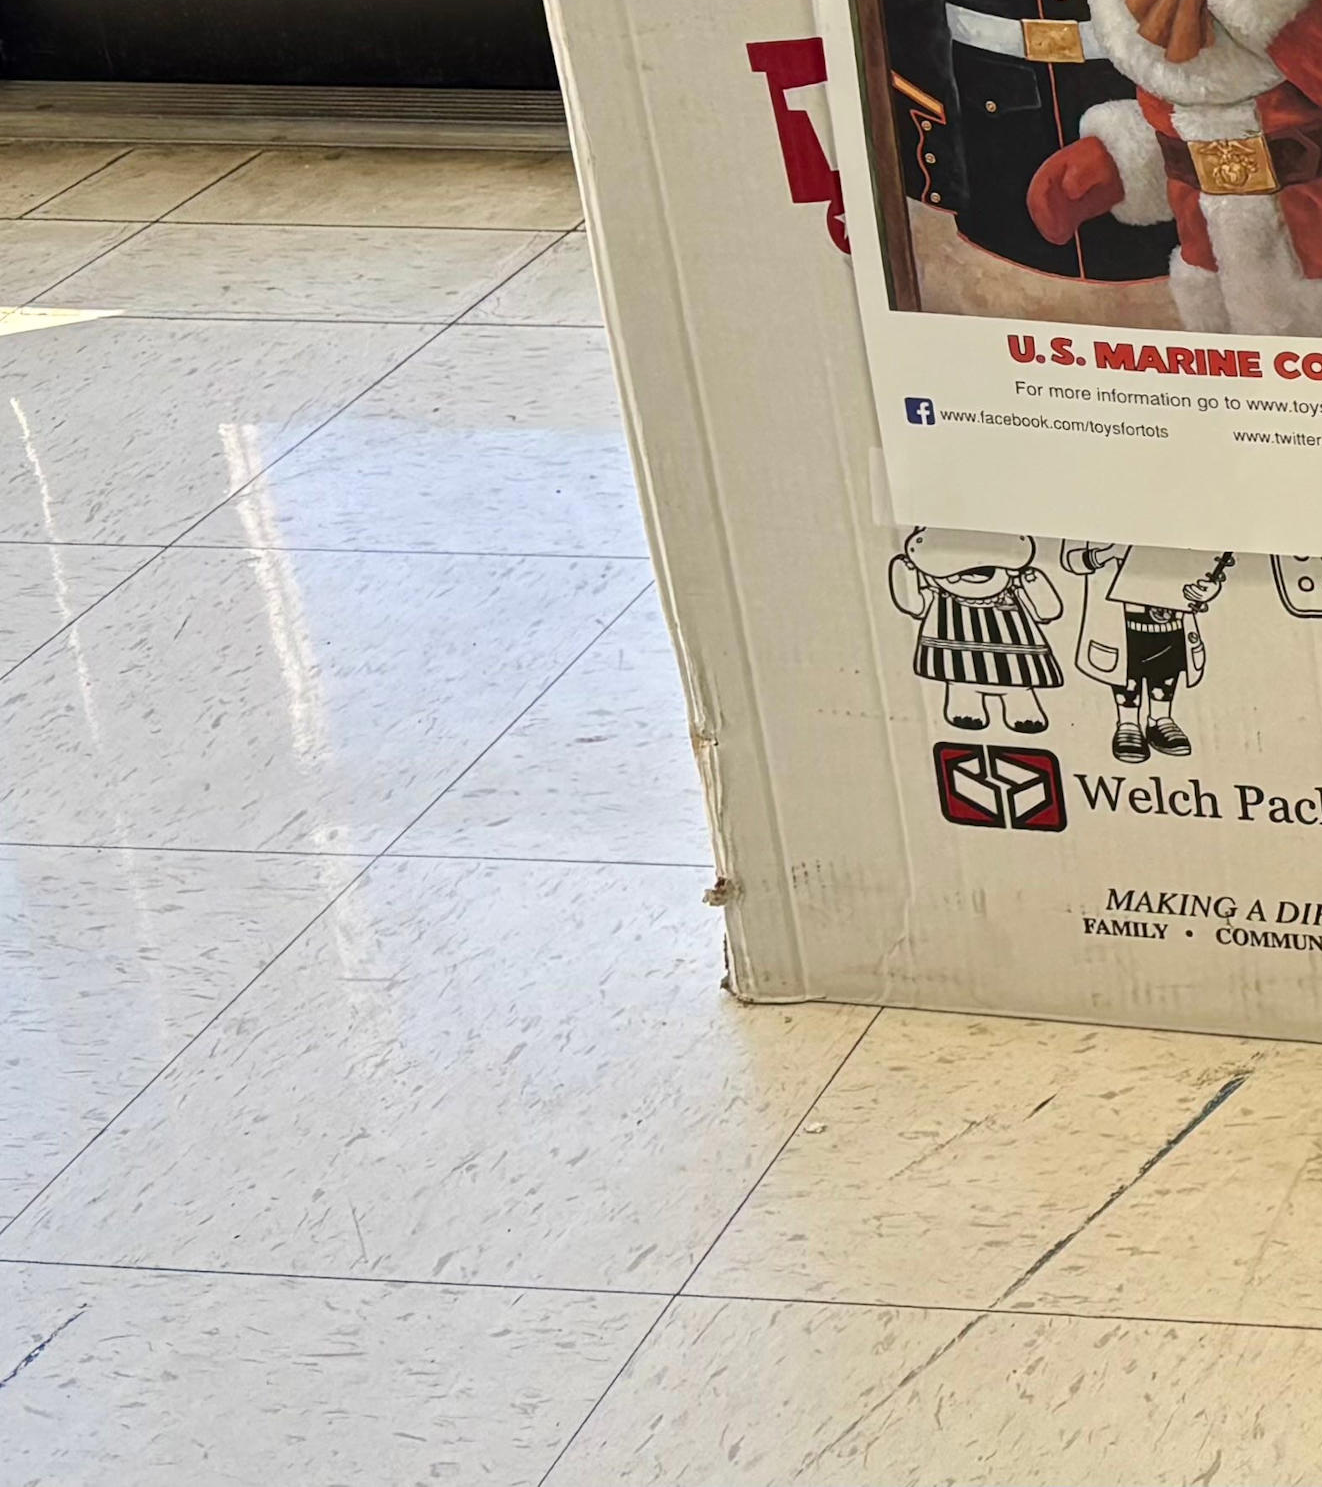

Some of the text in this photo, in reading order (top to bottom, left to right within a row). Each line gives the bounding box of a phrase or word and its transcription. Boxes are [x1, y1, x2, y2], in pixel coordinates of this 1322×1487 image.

[1007, 335, 1086, 366] U.S.
[1094, 341, 1262, 378] MARINE
[1016, 381, 1043, 396] For
[1049, 387, 1091, 400] more
[1097, 388, 1191, 407] information
[1197, 398, 1218, 411] go
[1225, 397, 1240, 410] to
[940, 411, 1168, 438] www.facebook.com/toysfortots
[1073, 774, 1222, 818] Welch
[1106, 889, 1238, 923] MAKING
[1246, 900, 1266, 922] A
[1083, 918, 1168, 939] FAMILY
